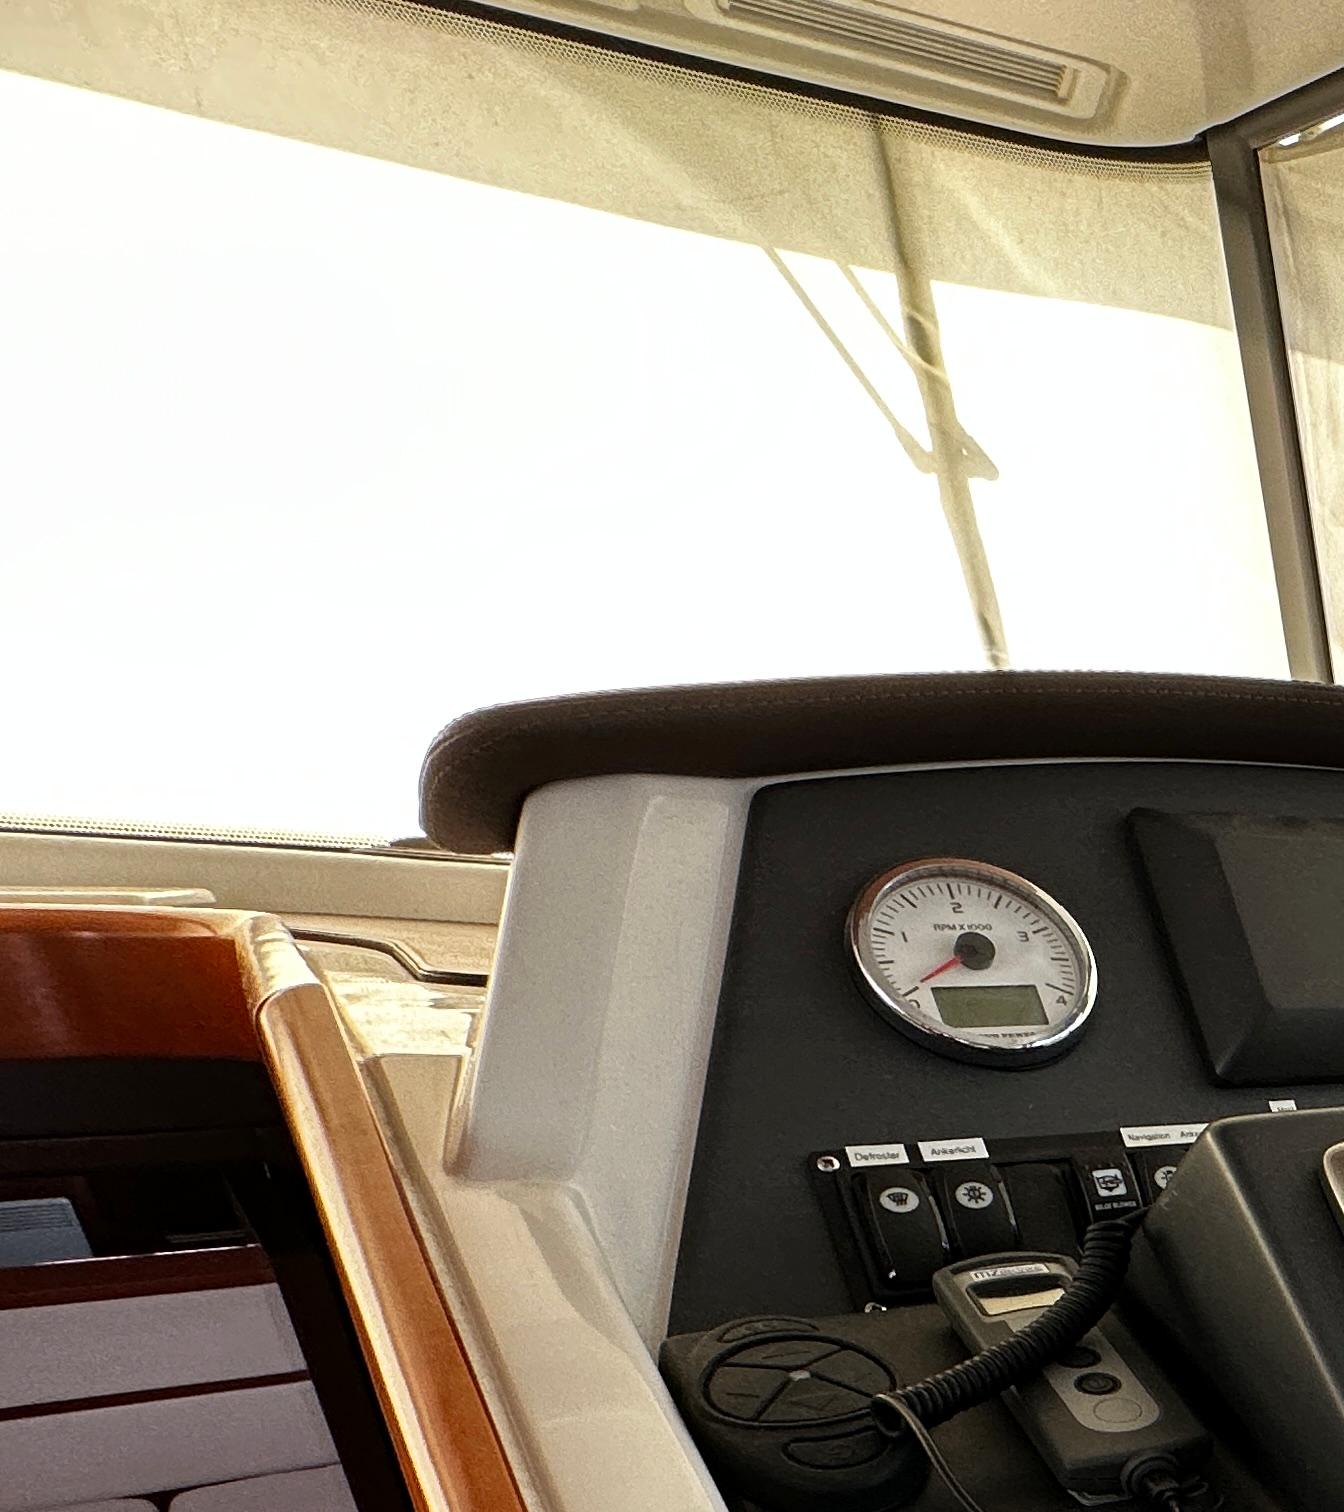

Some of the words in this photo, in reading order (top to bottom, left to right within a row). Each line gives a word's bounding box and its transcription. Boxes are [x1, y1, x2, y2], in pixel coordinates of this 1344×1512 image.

[951, 902, 964, 914] 2
[1017, 930, 1030, 942] 3
[1056, 995, 1068, 1006] 4
[854, 1152, 900, 1161] Defroster
